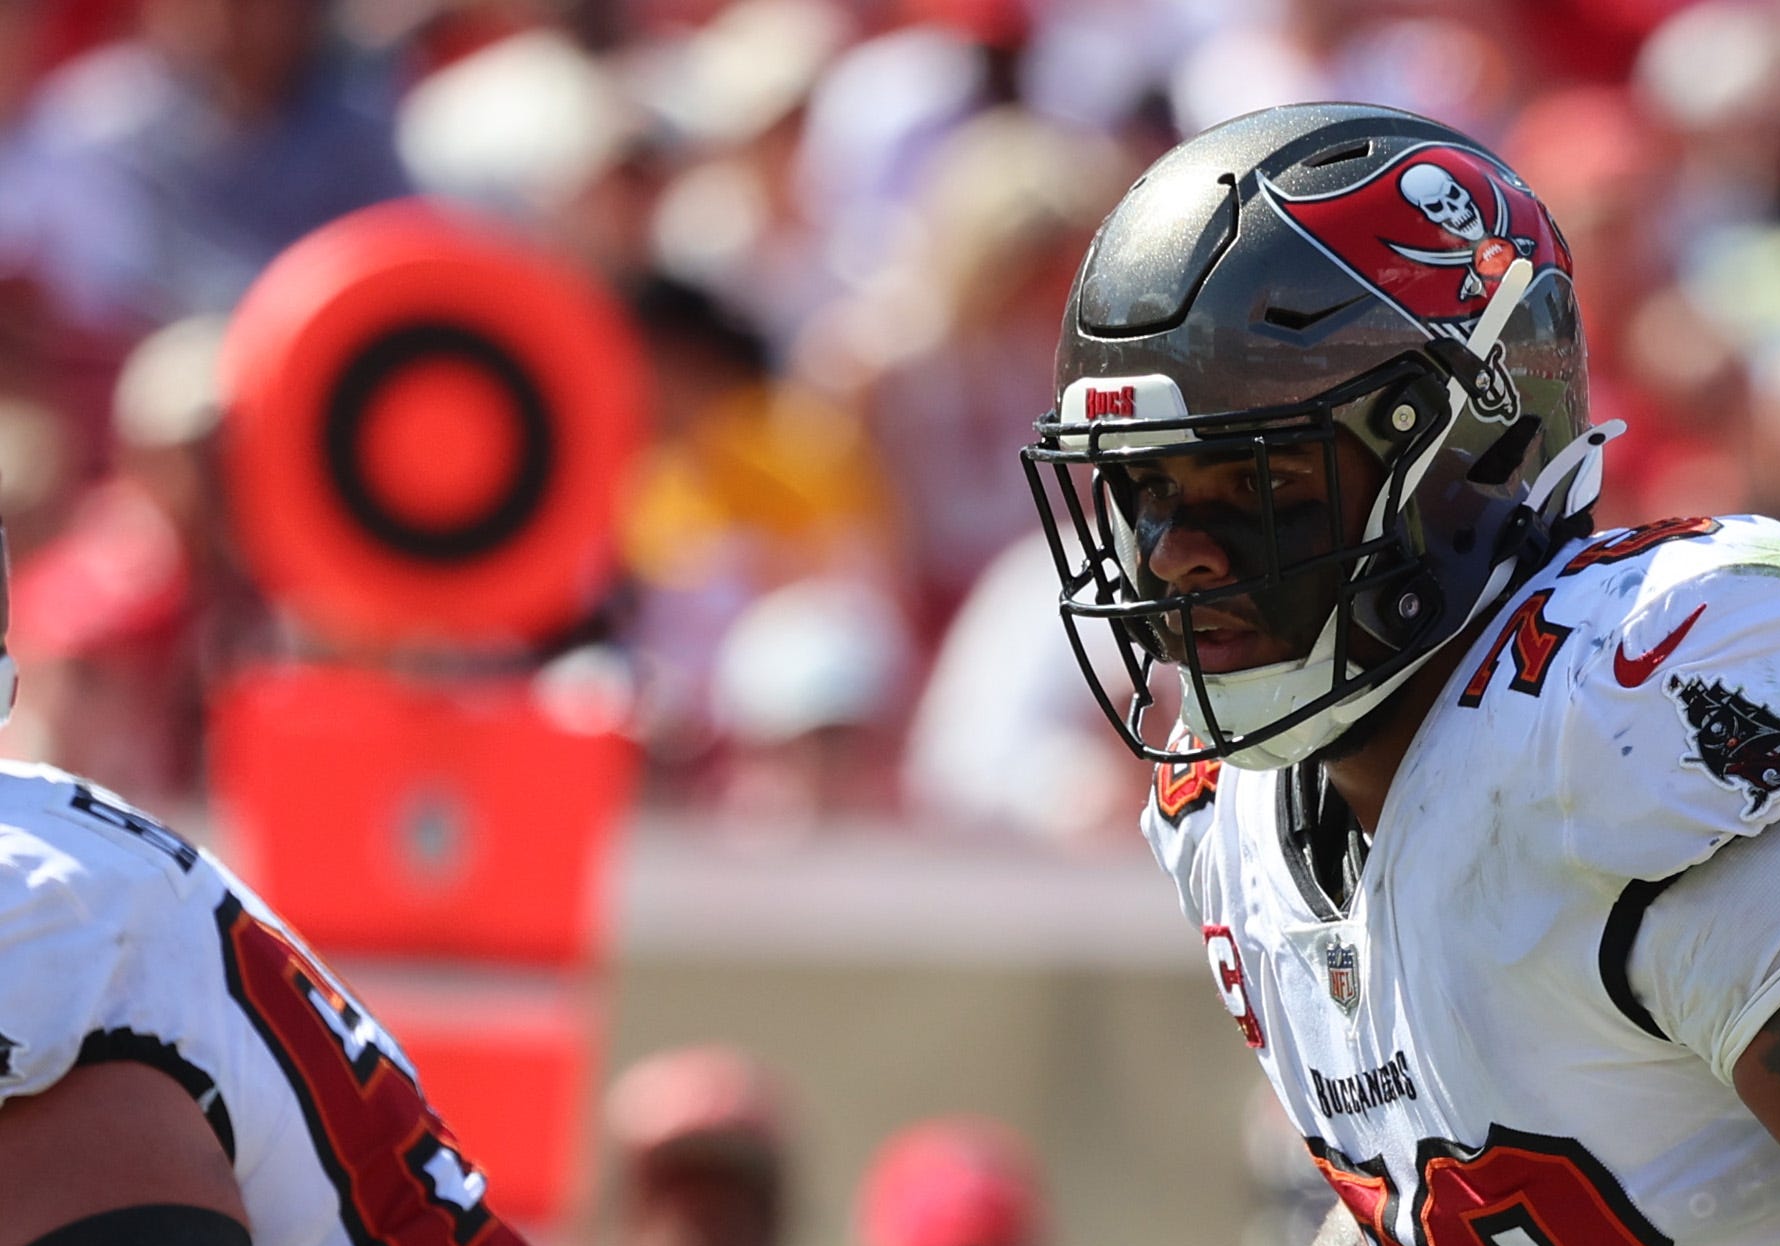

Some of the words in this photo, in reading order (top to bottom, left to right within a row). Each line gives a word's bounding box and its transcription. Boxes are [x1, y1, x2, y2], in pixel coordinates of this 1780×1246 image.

[1086, 386, 1135, 420] BUCS
[1330, 969, 1356, 1002] NFL
[1308, 1050, 1417, 1121] BUCCANEERS
